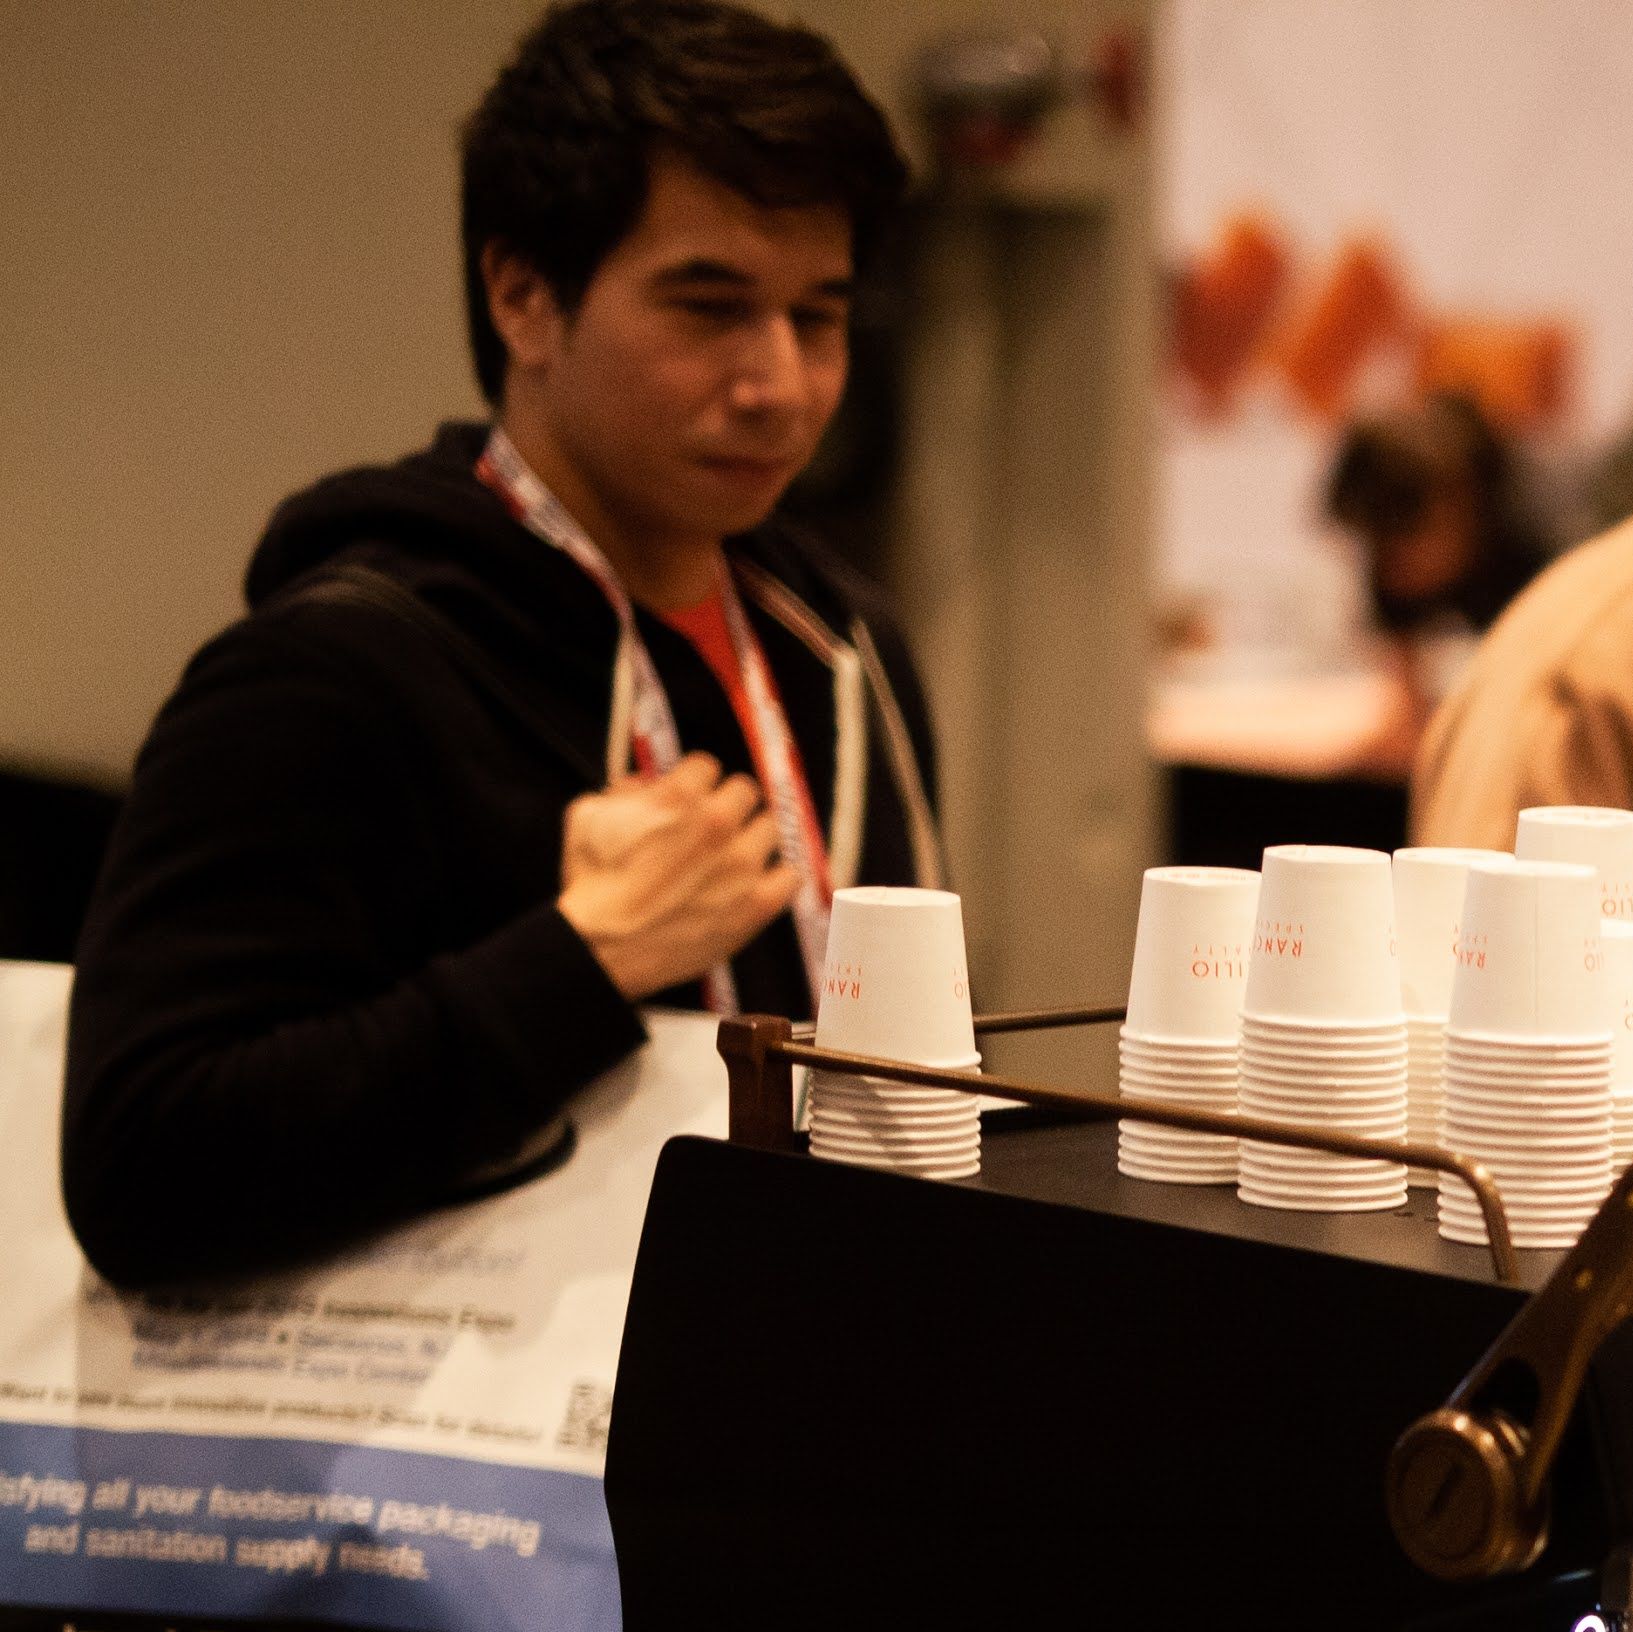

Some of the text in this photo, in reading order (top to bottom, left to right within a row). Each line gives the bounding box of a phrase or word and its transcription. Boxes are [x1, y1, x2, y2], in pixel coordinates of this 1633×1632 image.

[25, 1523, 80, 1555] and
[85, 1527, 228, 1564] sanitation
[236, 1532, 332, 1576] supply
[92, 1477, 132, 1512] all
[132, 1483, 200, 1519] your
[208, 1481, 374, 1522] foodservice
[378, 1495, 542, 1557] packaging
